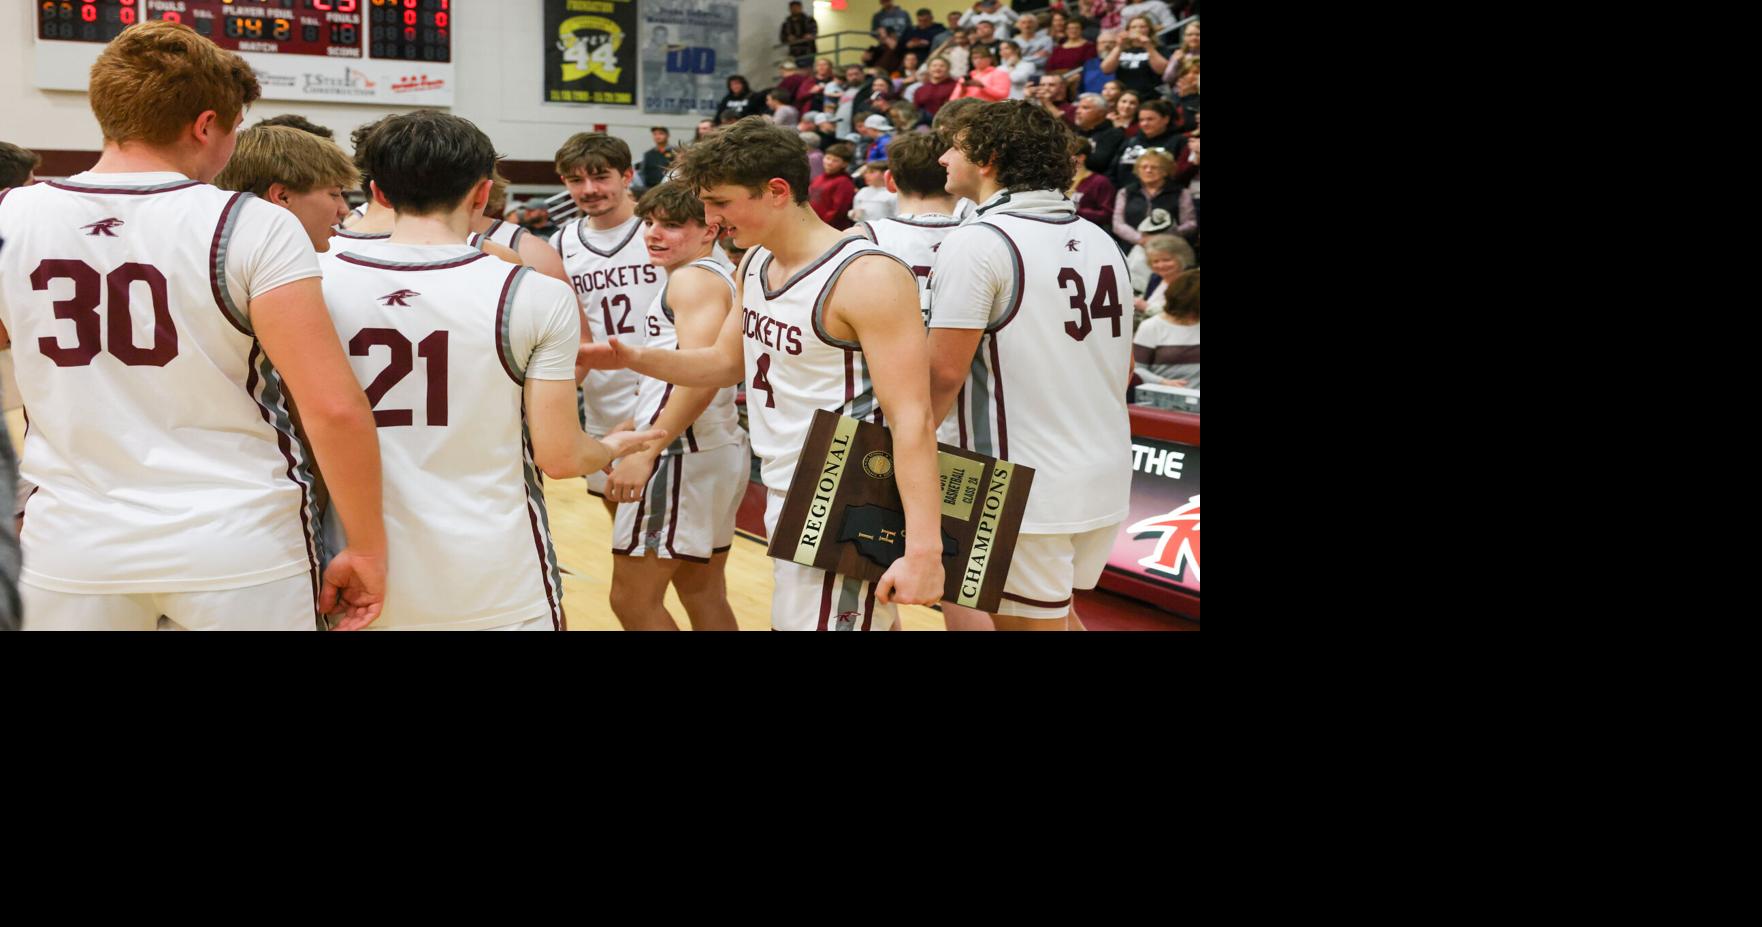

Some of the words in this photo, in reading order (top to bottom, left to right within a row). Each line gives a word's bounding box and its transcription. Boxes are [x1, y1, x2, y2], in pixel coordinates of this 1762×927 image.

[148, 2, 186, 12] FOULS
[222, 6, 264, 16] PLAYER
[267, 9, 295, 19] FOUL
[326, 12, 360, 23] FOULS
[327, 47, 360, 57] SCORE
[563, 42, 618, 71] 44
[572, 264, 657, 295] ROCKETS
[30, 259, 179, 367] 30
[601, 294, 635, 336] 12
[1057, 265, 1123, 341] 34
[742, 306, 802, 355] OCKETS
[349, 328, 449, 427] 21
[753, 353, 775, 408] 4
[1131, 443, 1185, 479] THE
[801, 434, 849, 548] REGIONAL
[944, 468, 965, 505] BASKETBALL
[962, 486, 976, 504] CLASS
[962, 468, 1008, 598] CHAMPIONS
